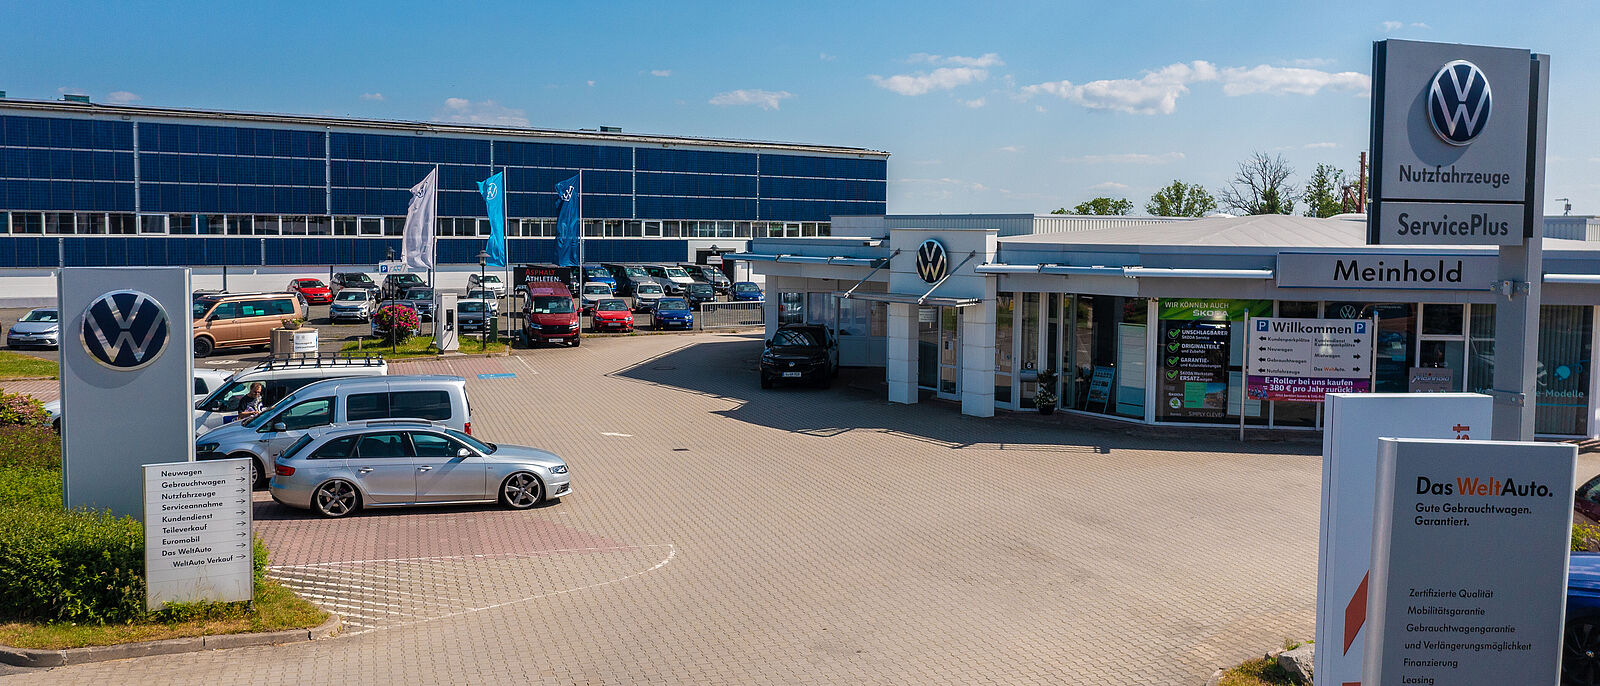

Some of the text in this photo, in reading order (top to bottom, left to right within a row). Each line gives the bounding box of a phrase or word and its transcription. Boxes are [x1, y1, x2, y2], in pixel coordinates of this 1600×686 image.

[1399, 164, 1510, 188] Nutzfahrzeuge
[1397, 212, 1509, 236] ServicePlus
[1333, 259, 1463, 283] Meinhold
[1180, 301, 1208, 309] KÖNNEN
[1272, 321, 1352, 335] Willkommen
[1264, 376, 1297, 385] E-Roller
[1298, 377, 1310, 385] bei
[1327, 378, 1353, 386] kaufen
[161, 469, 203, 478] Neuwagen
[161, 479, 226, 489] Gebrauchtwagen
[1416, 475, 1554, 498] Das WeltAuto.
[161, 491, 216, 500] Nutzfahrzeuge
[162, 501, 224, 511] Serviceannahme
[1415, 502, 1532, 516] Gute Gebrauchtwagen.
[162, 513, 213, 523] Kundendienst
[1414, 515, 1470, 527] Garantiert.
[162, 523, 208, 534] Teileverkauf
[162, 535, 200, 546] Euromobil
[177, 546, 212, 555] WeltAuto
[172, 555, 234, 568] WeltAuto Verkauf
[1408, 588, 1494, 600] Zertifizierte Qualität
[1407, 605, 1486, 618] Mobilitätsgarantie
[1406, 623, 1516, 635] Gebrauchtwagengarantie
[1404, 640, 1532, 652] und Verlängerungsmöglichkeit
[1403, 657, 1459, 669] Finanzierung
[1402, 675, 1435, 686] Leasing
